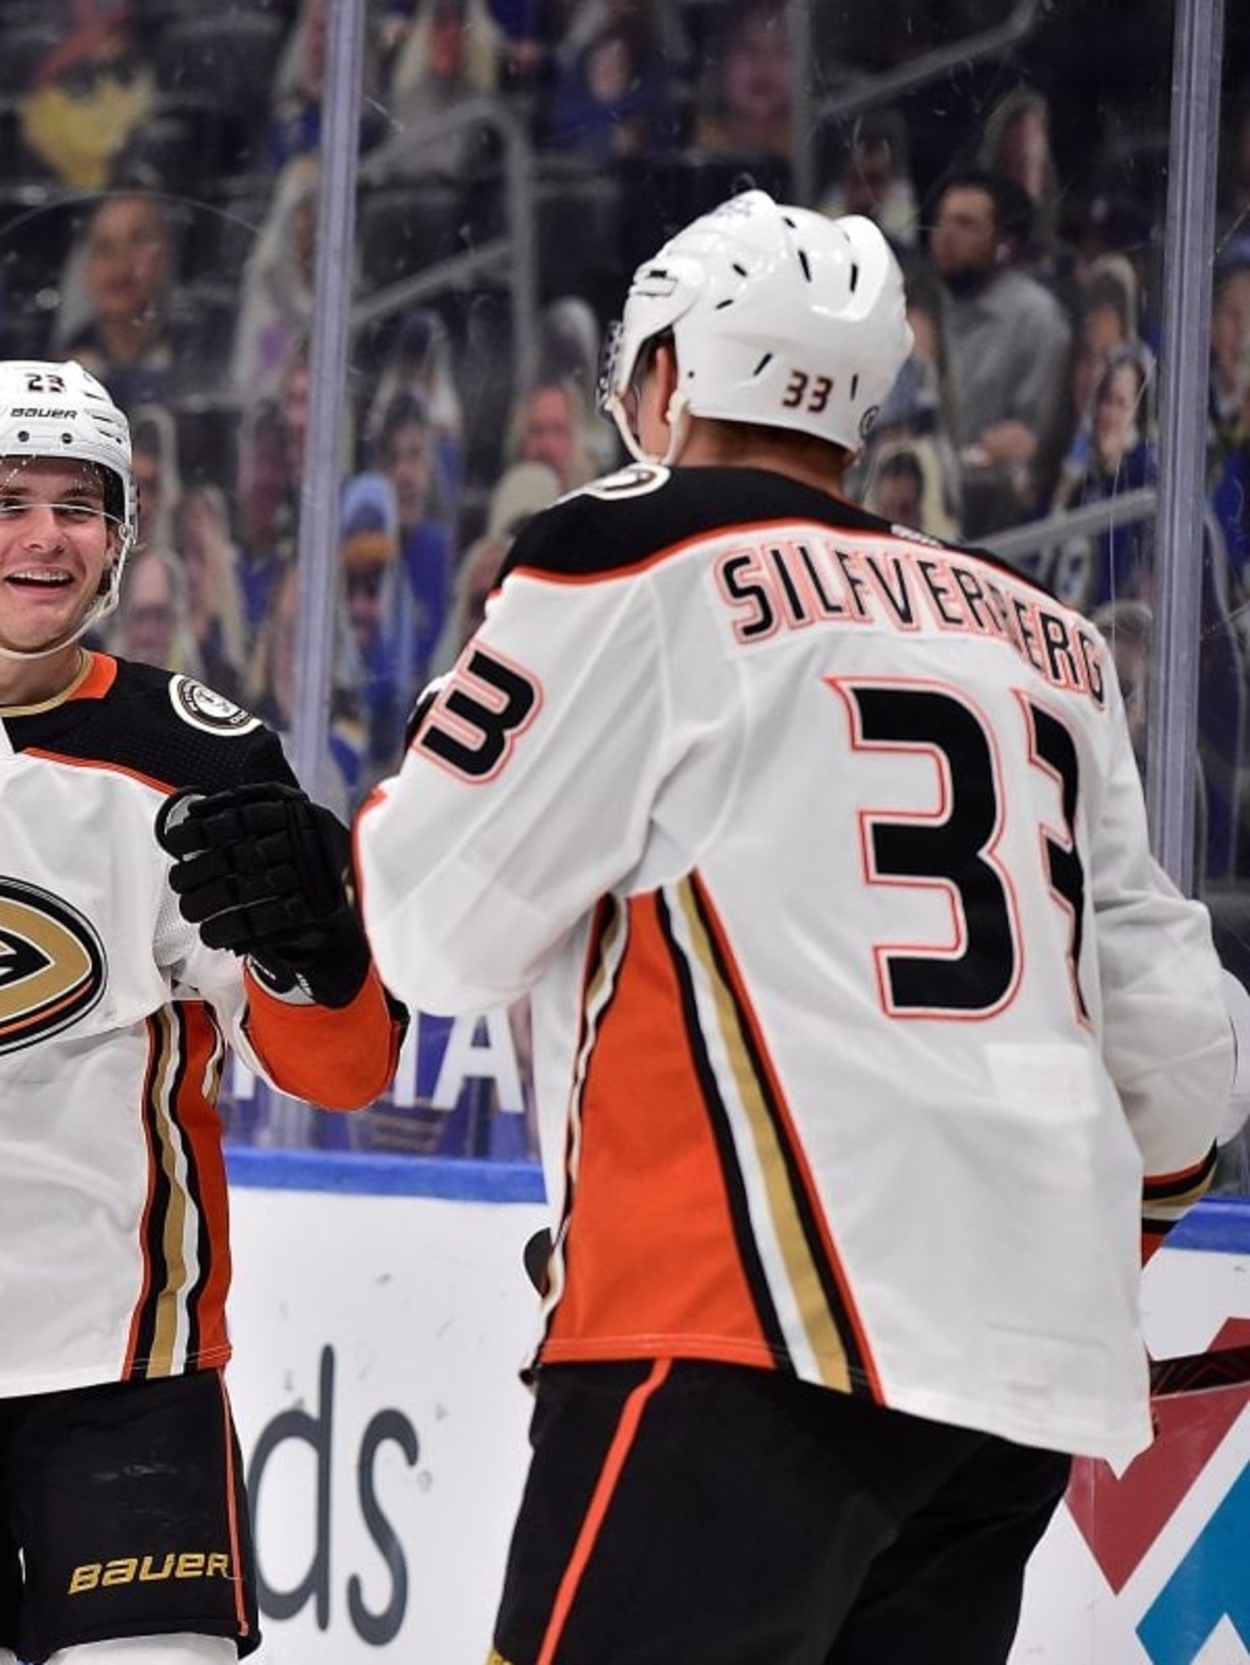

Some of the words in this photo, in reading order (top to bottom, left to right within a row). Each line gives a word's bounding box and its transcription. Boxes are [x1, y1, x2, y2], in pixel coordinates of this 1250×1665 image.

[25, 373, 65, 393] 23
[781, 369, 833, 415] 33
[10, 407, 78, 420] BAUER
[828, 680, 1090, 1025] 33
[248, 1343, 420, 1646] ds
[67, 1552, 232, 1596] BAUER
